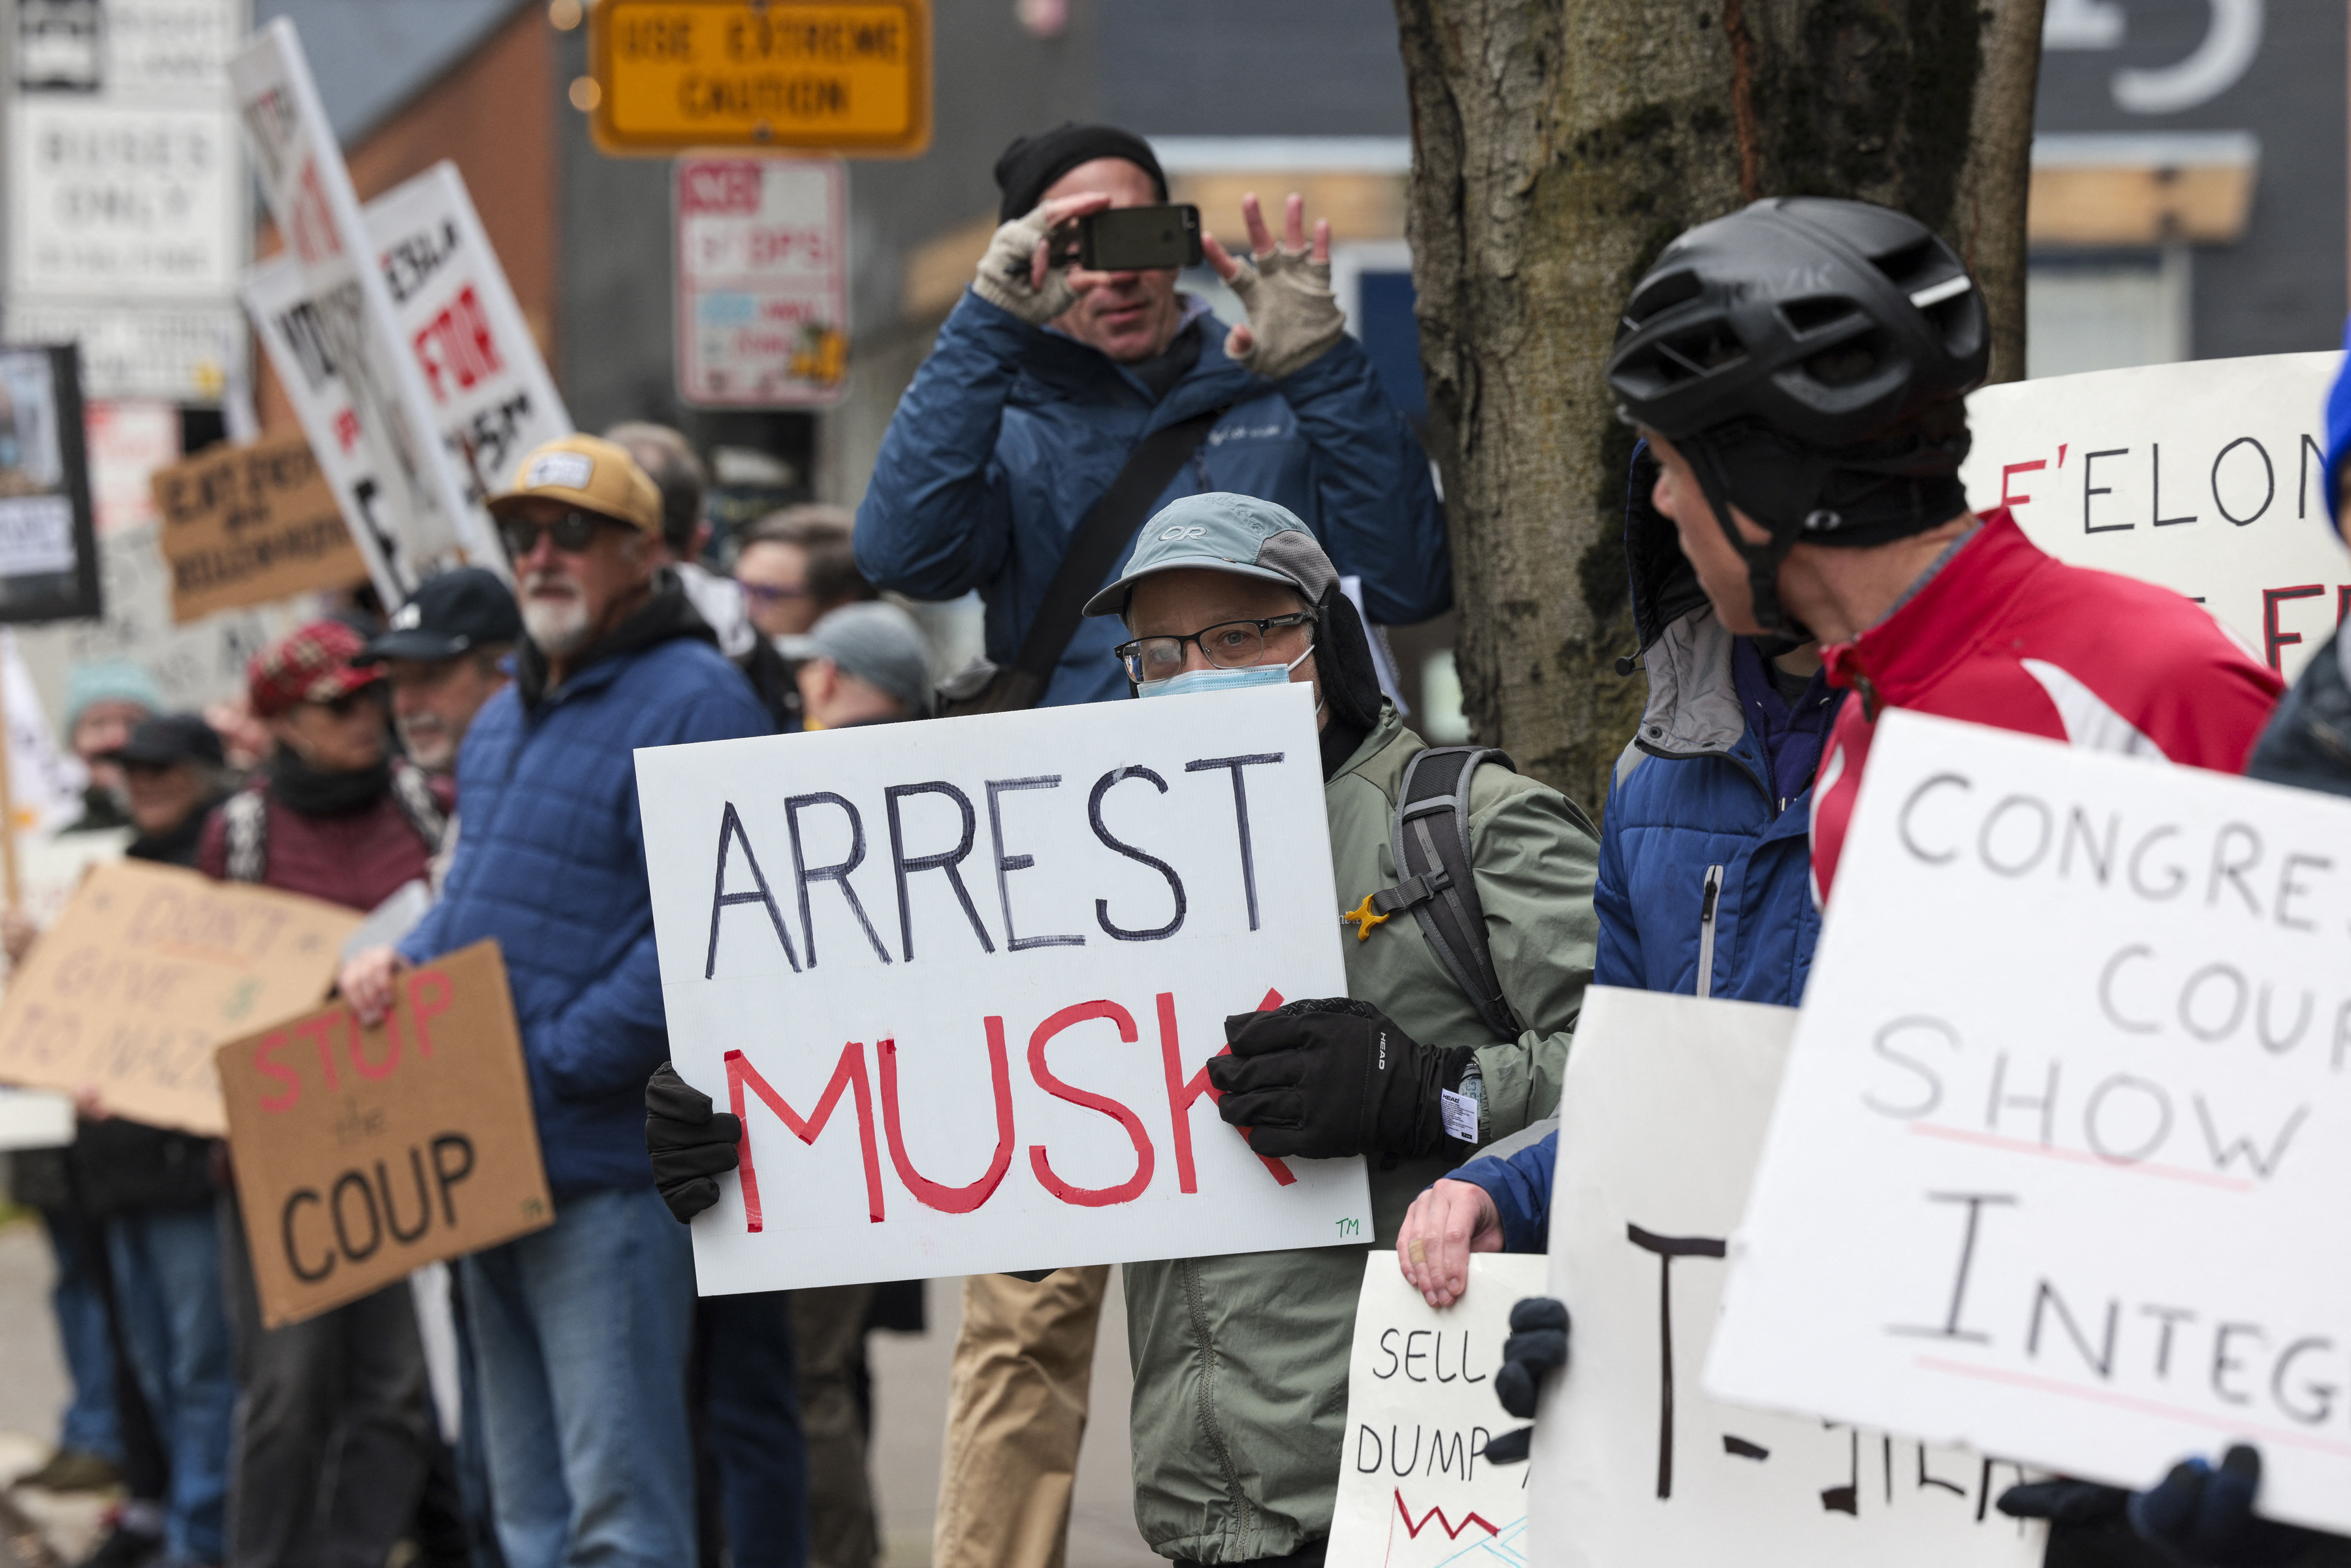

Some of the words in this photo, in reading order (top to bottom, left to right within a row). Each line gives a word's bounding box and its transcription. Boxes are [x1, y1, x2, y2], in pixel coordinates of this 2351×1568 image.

[680, 76, 848, 119] CAUTION
[728, 19, 904, 60] EXTREME
[705, 752, 1285, 980] ARREST
[1896, 771, 2351, 940] CONGRE
[253, 970, 455, 1114] STOP
[724, 987, 1298, 1234] MUSK
[1442, 1094, 1459, 1104] HEAD
[1859, 1014, 2312, 1179] SHOW
[280, 1131, 476, 1283] COUP
[1335, 1218, 1360, 1238] TM
[1372, 1328, 1486, 1384] SELL
[1882, 1189, 2351, 1427] INTEG
[1357, 1424, 1490, 1482] DUMP
